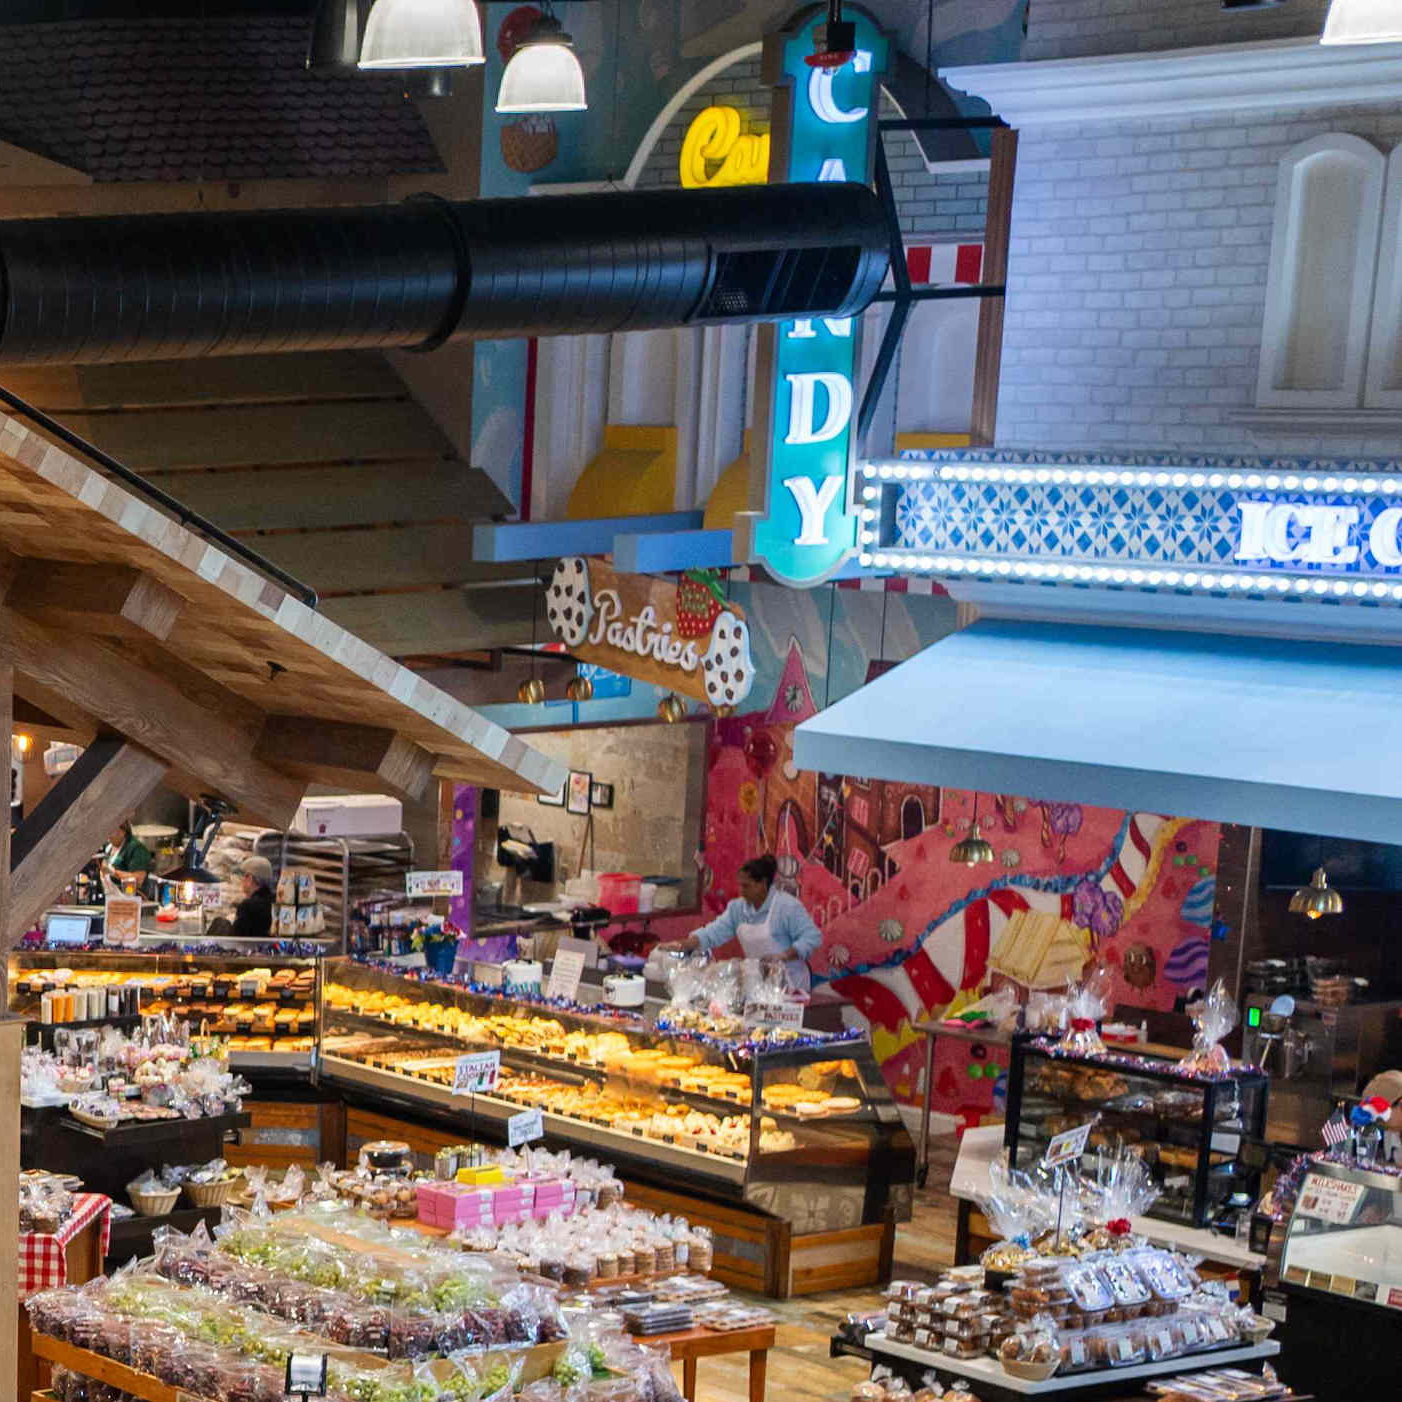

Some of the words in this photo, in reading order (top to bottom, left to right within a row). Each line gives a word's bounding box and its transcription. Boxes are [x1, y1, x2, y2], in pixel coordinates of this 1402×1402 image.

[783, 49, 872, 545] CDY
[1234, 502, 1359, 564] ICE
[588, 588, 699, 672] Pastries
